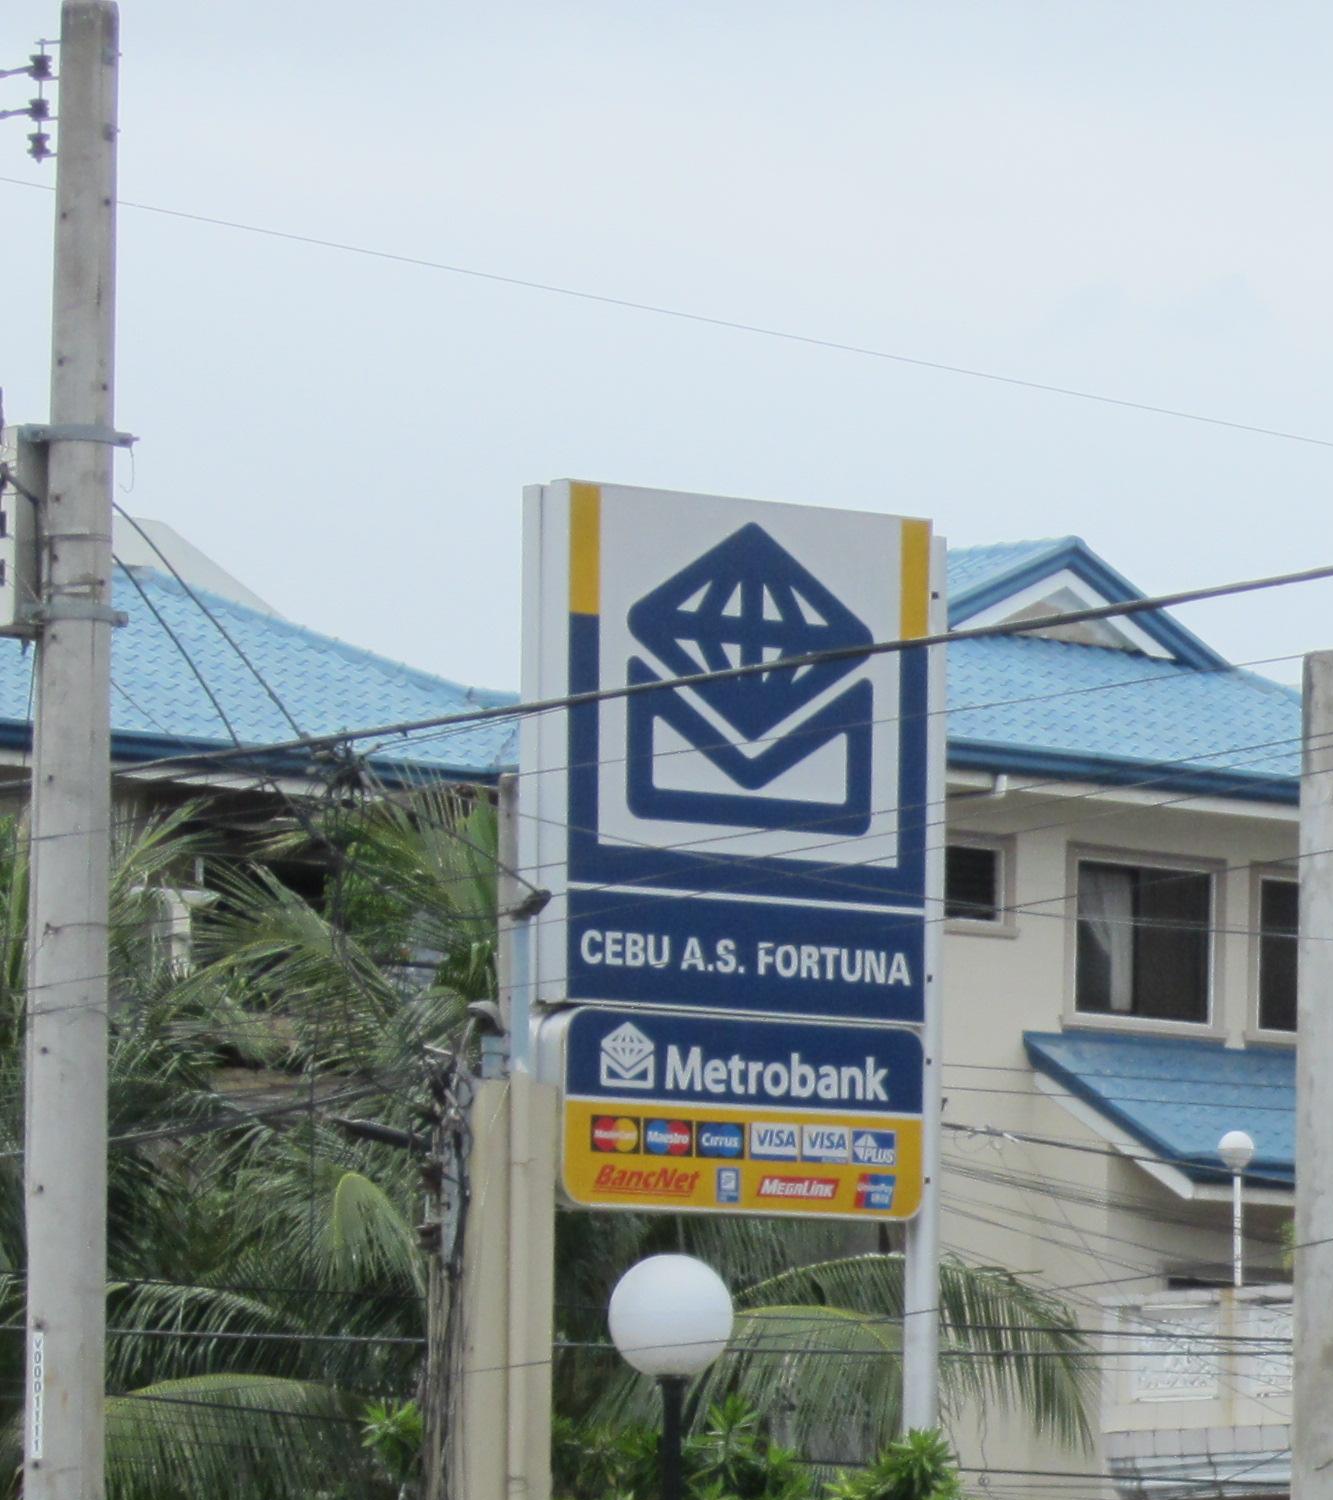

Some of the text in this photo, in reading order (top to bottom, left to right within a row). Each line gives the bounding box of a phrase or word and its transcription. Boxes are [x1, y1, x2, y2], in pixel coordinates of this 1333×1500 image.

[580, 929, 911, 987] CEBU A.S. FORTUNA
[665, 1044, 889, 1101] Metrobank
[646, 1130, 690, 1145] Maestro
[701, 1132, 739, 1148] Cirrus
[756, 1128, 797, 1148] VISA
[808, 1131, 847, 1150] VISA
[865, 1147, 896, 1163] PLUS
[594, 1163, 701, 1192] BancNet
